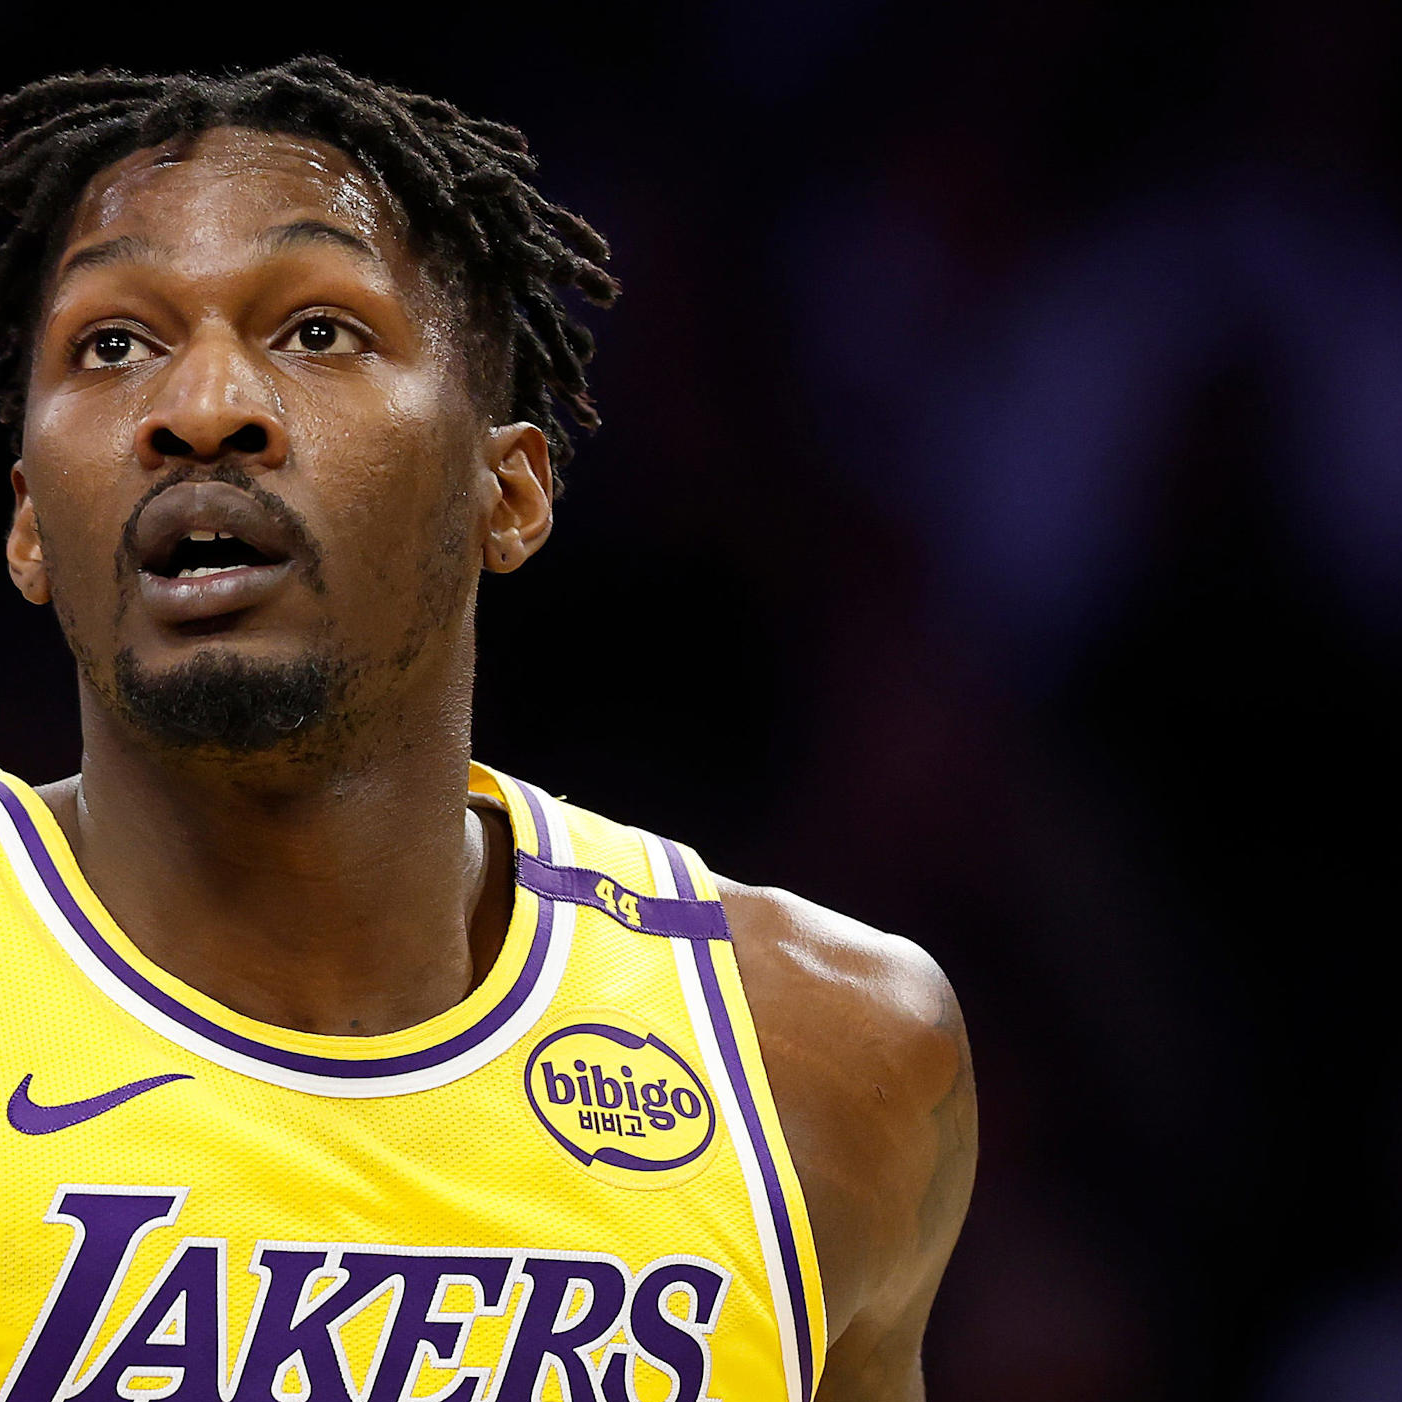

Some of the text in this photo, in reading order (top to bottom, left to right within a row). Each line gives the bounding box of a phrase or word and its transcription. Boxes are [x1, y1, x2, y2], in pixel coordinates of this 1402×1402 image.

[594, 877, 643, 927] 44
[540, 1059, 702, 1131] bibigo
[578, 1110, 647, 1138] 비비고
